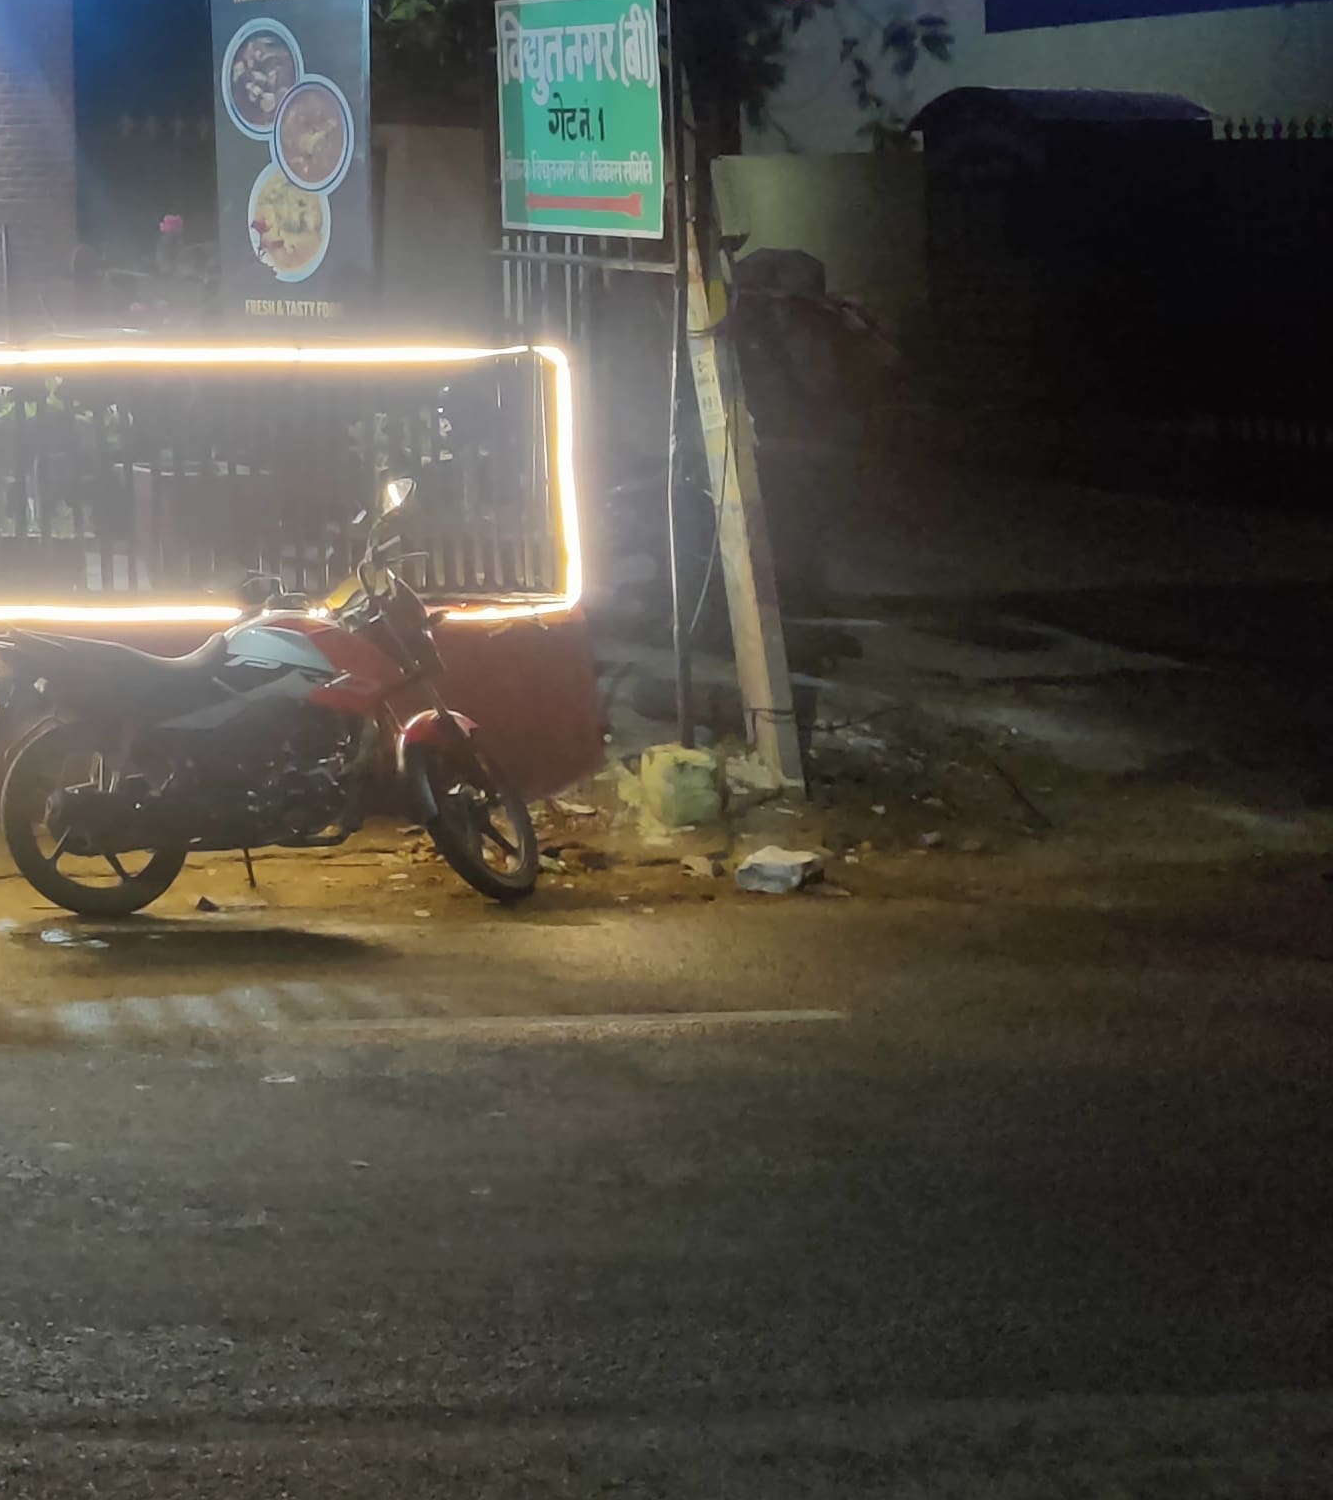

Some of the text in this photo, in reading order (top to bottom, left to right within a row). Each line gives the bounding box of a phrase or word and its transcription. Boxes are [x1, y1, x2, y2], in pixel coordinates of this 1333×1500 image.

[547, 91, 577, 142] गेट
[598, 107, 605, 142] 1
[244, 299, 276, 316] FRESH
[285, 300, 316, 317] TASTY
